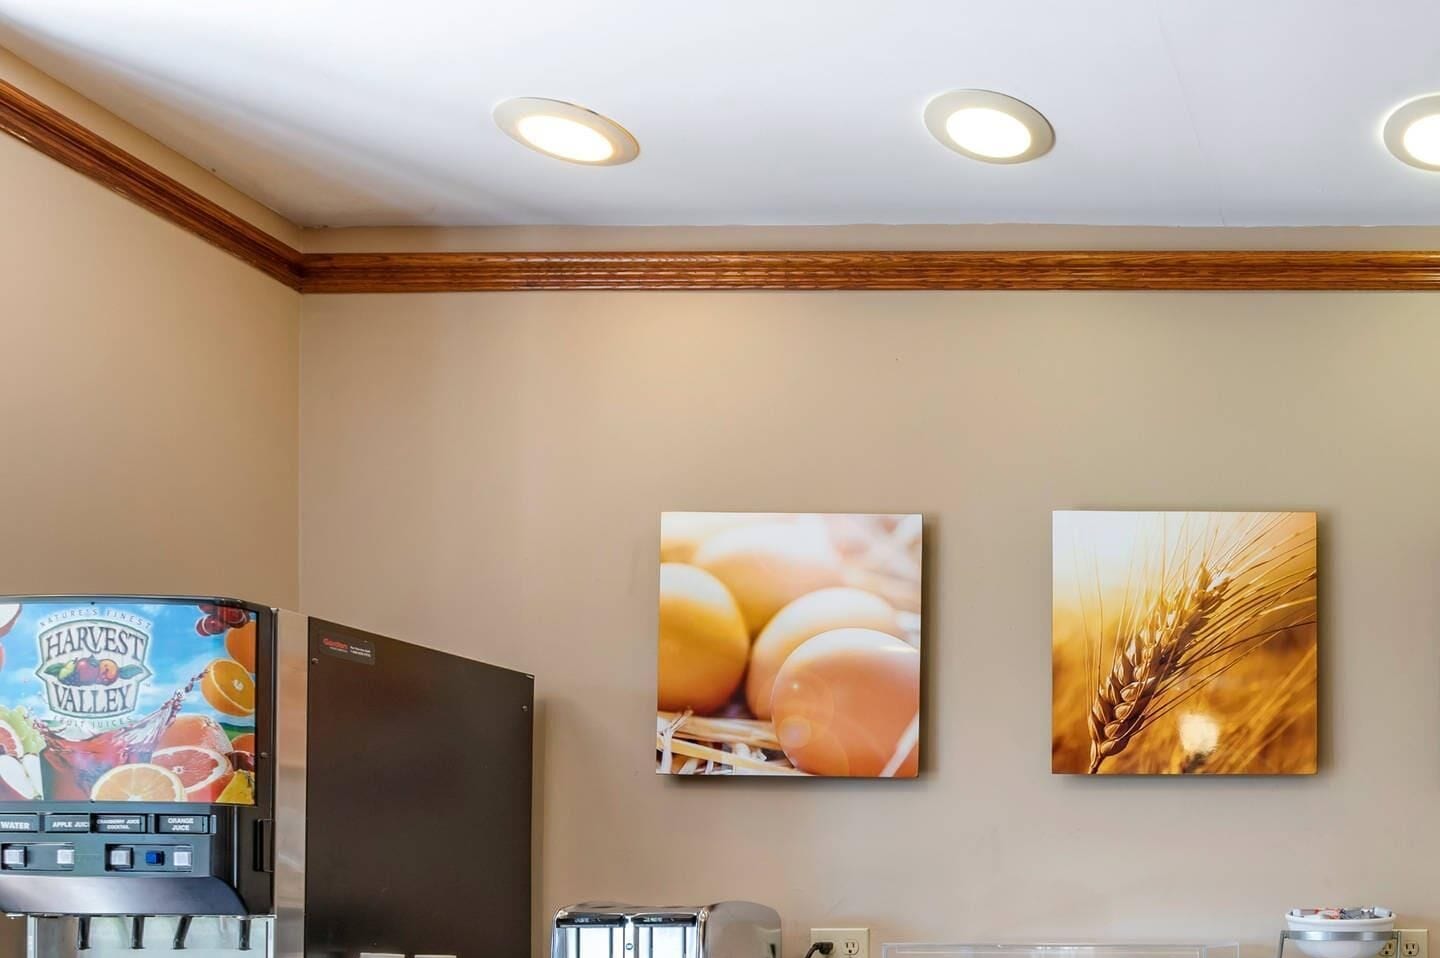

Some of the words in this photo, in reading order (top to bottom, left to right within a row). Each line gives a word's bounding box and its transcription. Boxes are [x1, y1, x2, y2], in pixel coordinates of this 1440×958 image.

[106, 608, 152, 630] FINEST
[45, 626, 144, 661] HARVEST
[52, 681, 132, 713] VALLEY
[0, 821, 30, 830] WATER
